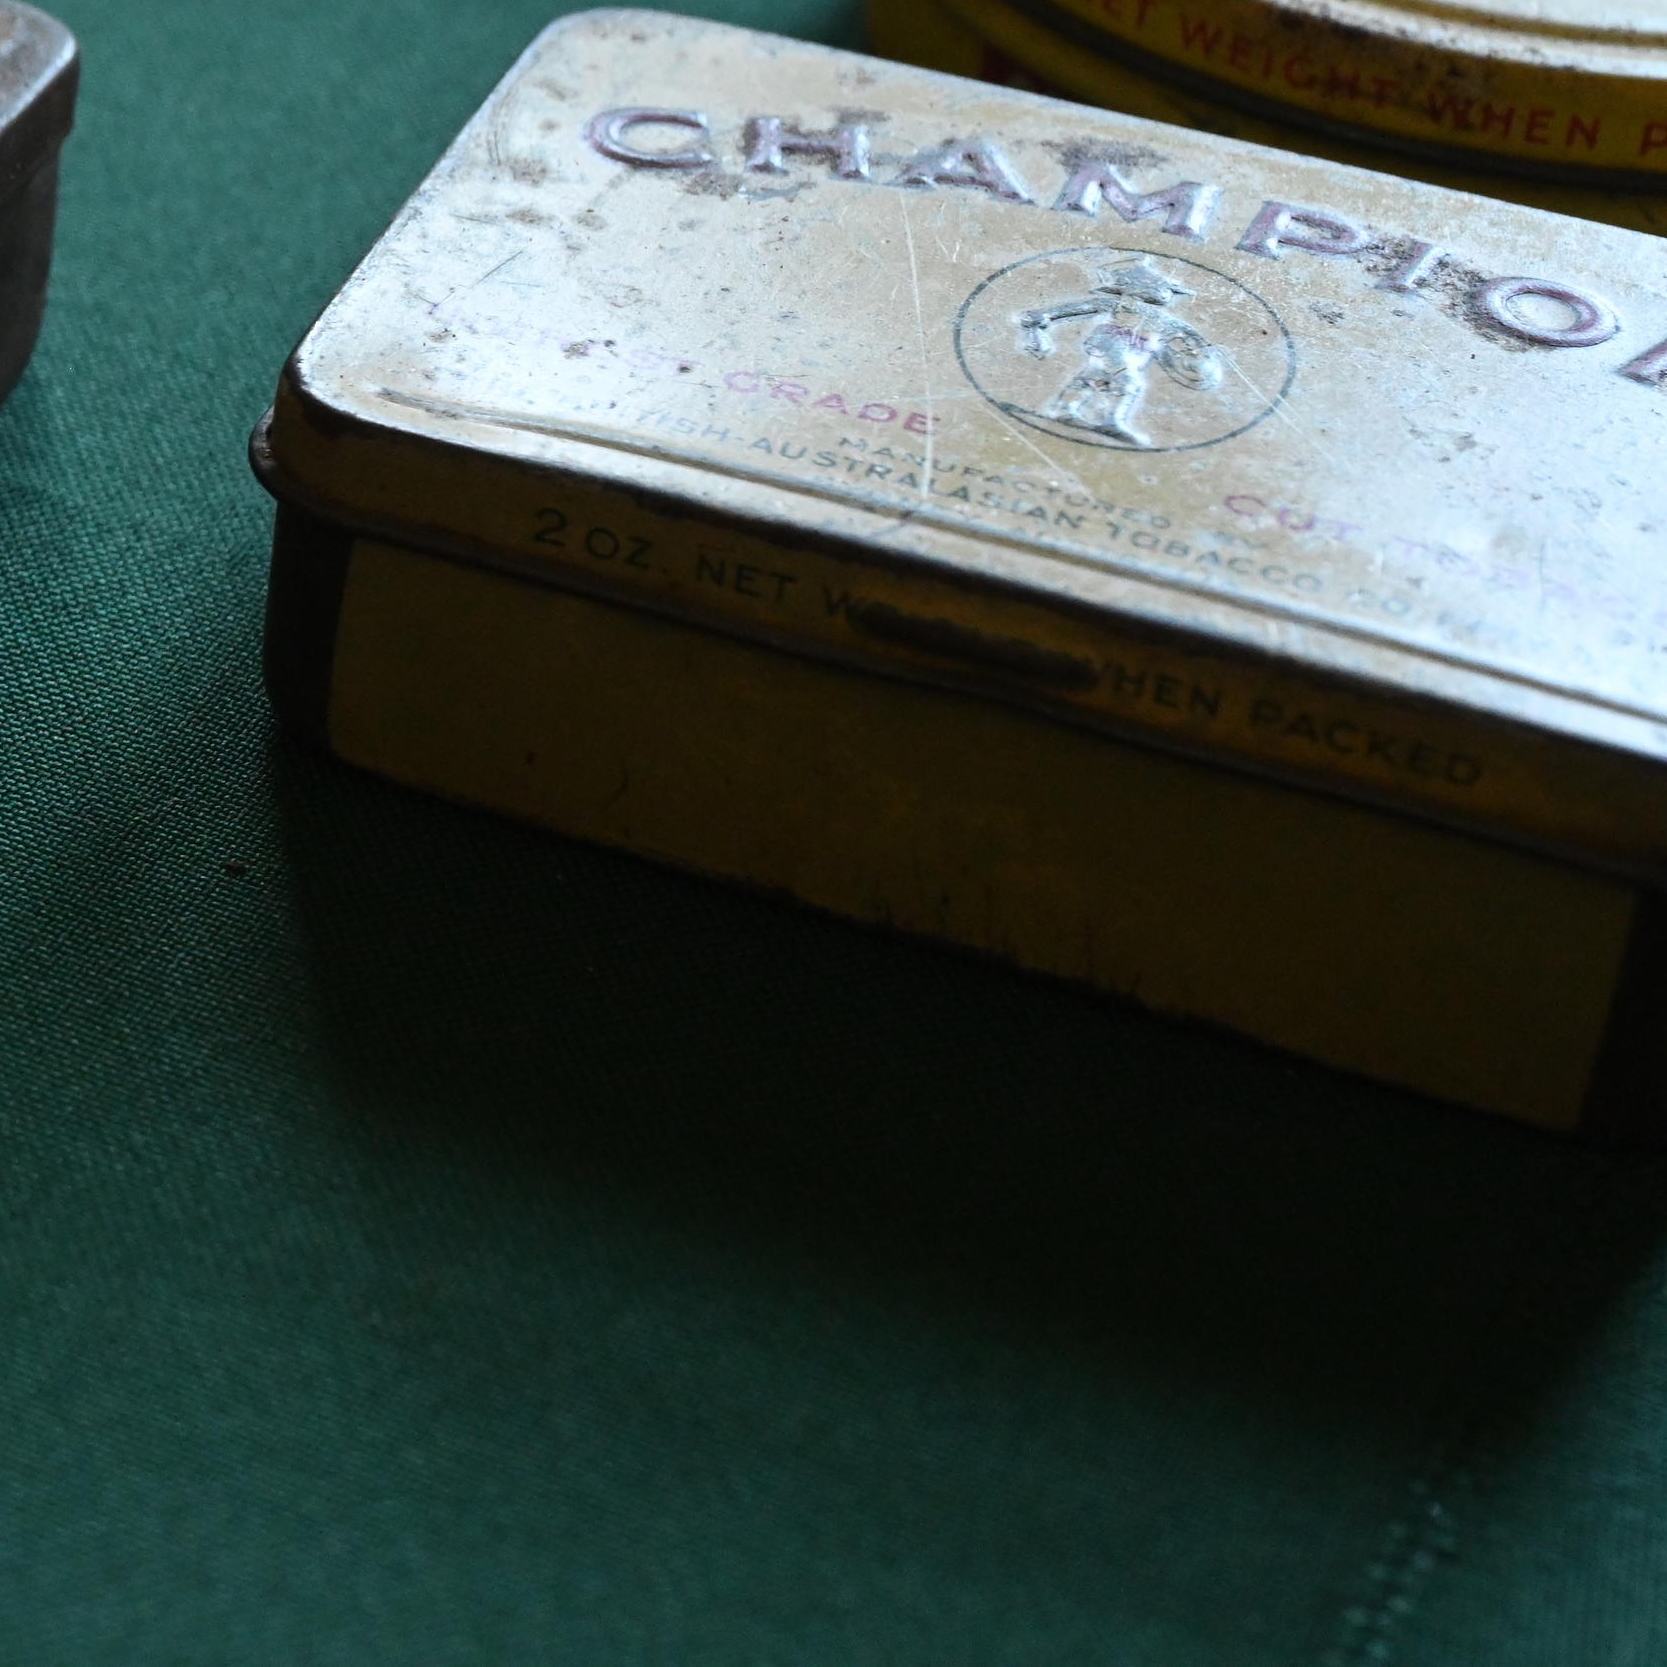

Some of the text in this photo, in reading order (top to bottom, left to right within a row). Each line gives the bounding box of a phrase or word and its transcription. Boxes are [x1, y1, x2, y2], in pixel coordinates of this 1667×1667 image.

[1179, 12, 1397, 109] WEIGHT
[1426, 88, 1601, 151] WHEN
[724, 370, 942, 436] GRADE
[532, 506, 569, 549] 2
[695, 553, 800, 603] NET
[1107, 520, 1324, 594] TOBACCO
[1250, 696, 1483, 786] PACKED
